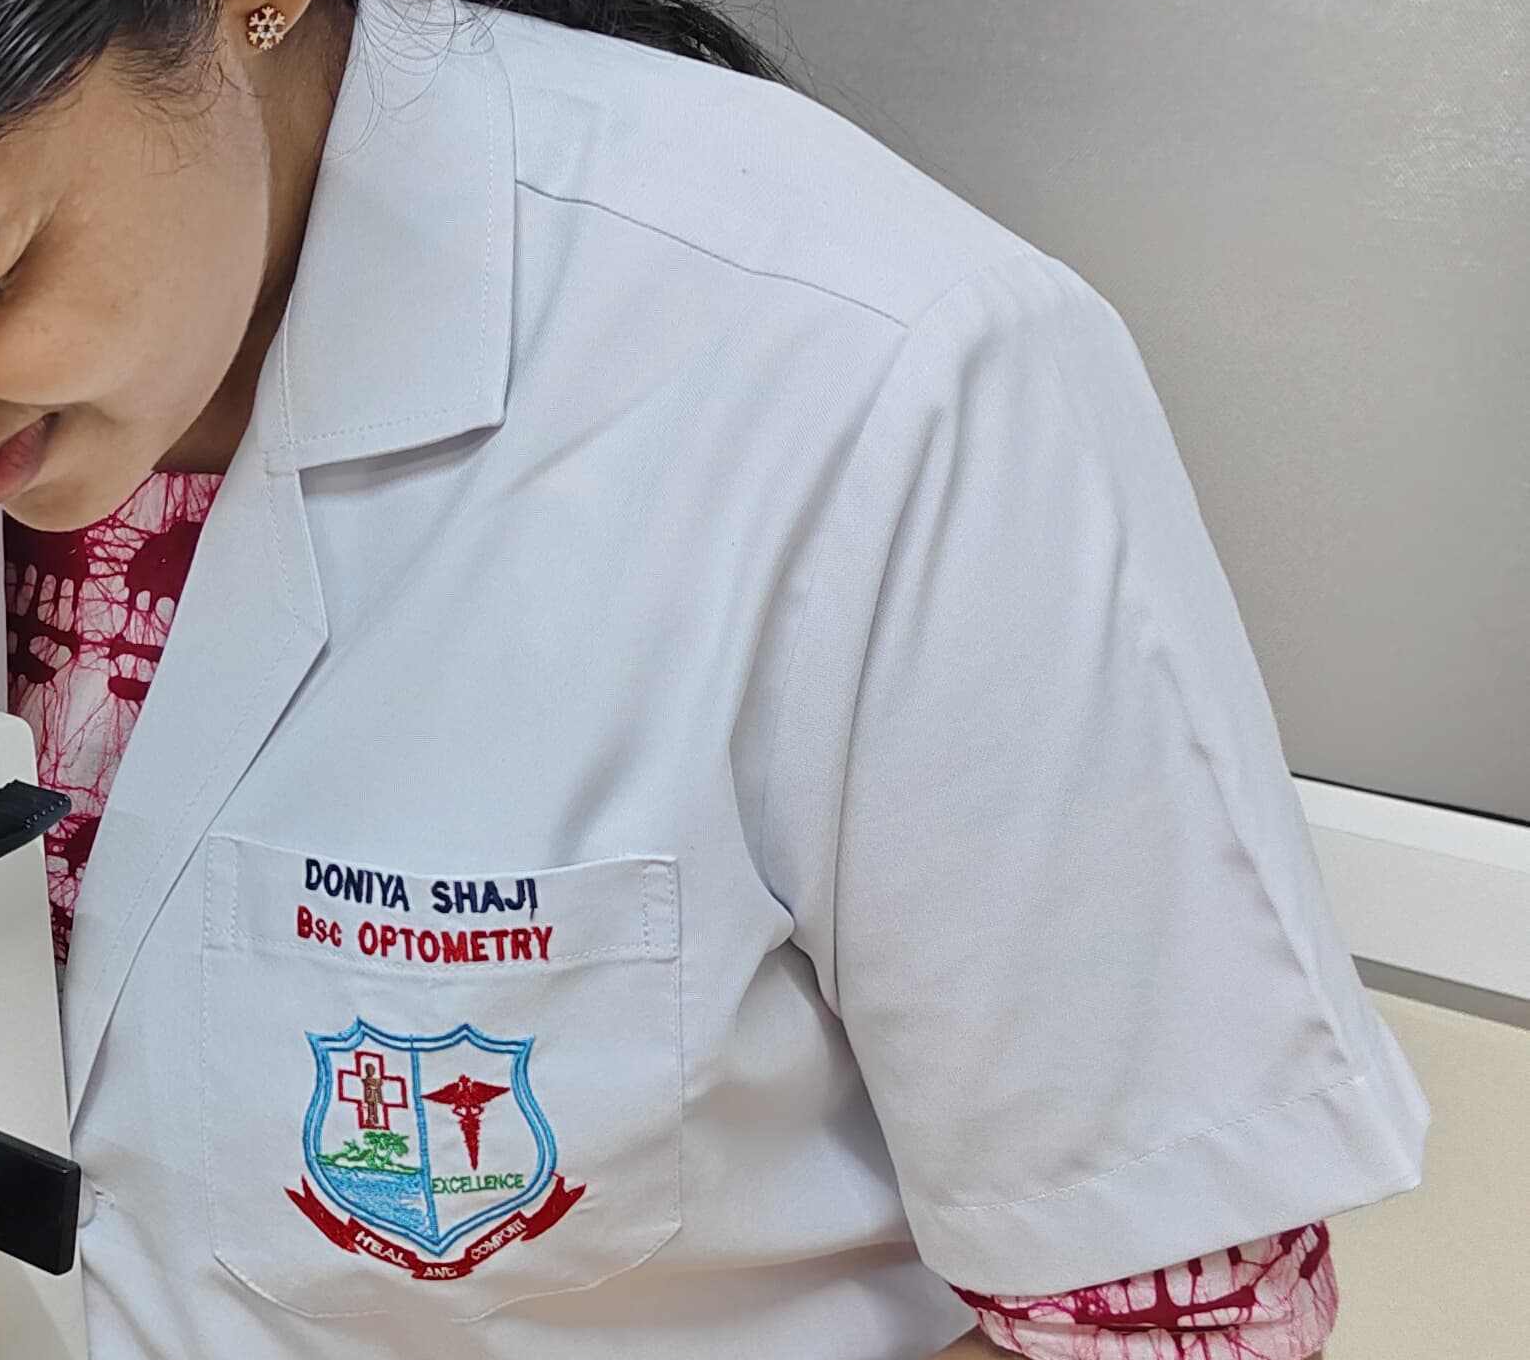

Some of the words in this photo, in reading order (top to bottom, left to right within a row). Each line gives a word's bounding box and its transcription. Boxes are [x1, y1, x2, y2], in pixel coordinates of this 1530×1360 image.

[305, 858, 410, 912] DONIYA
[431, 878, 538, 915] SHAJI
[358, 921, 553, 964] OPTOMETRY
[432, 1174, 525, 1194] EXCELLENCE
[354, 1229, 410, 1268] HEAL
[422, 1265, 458, 1279] AND
